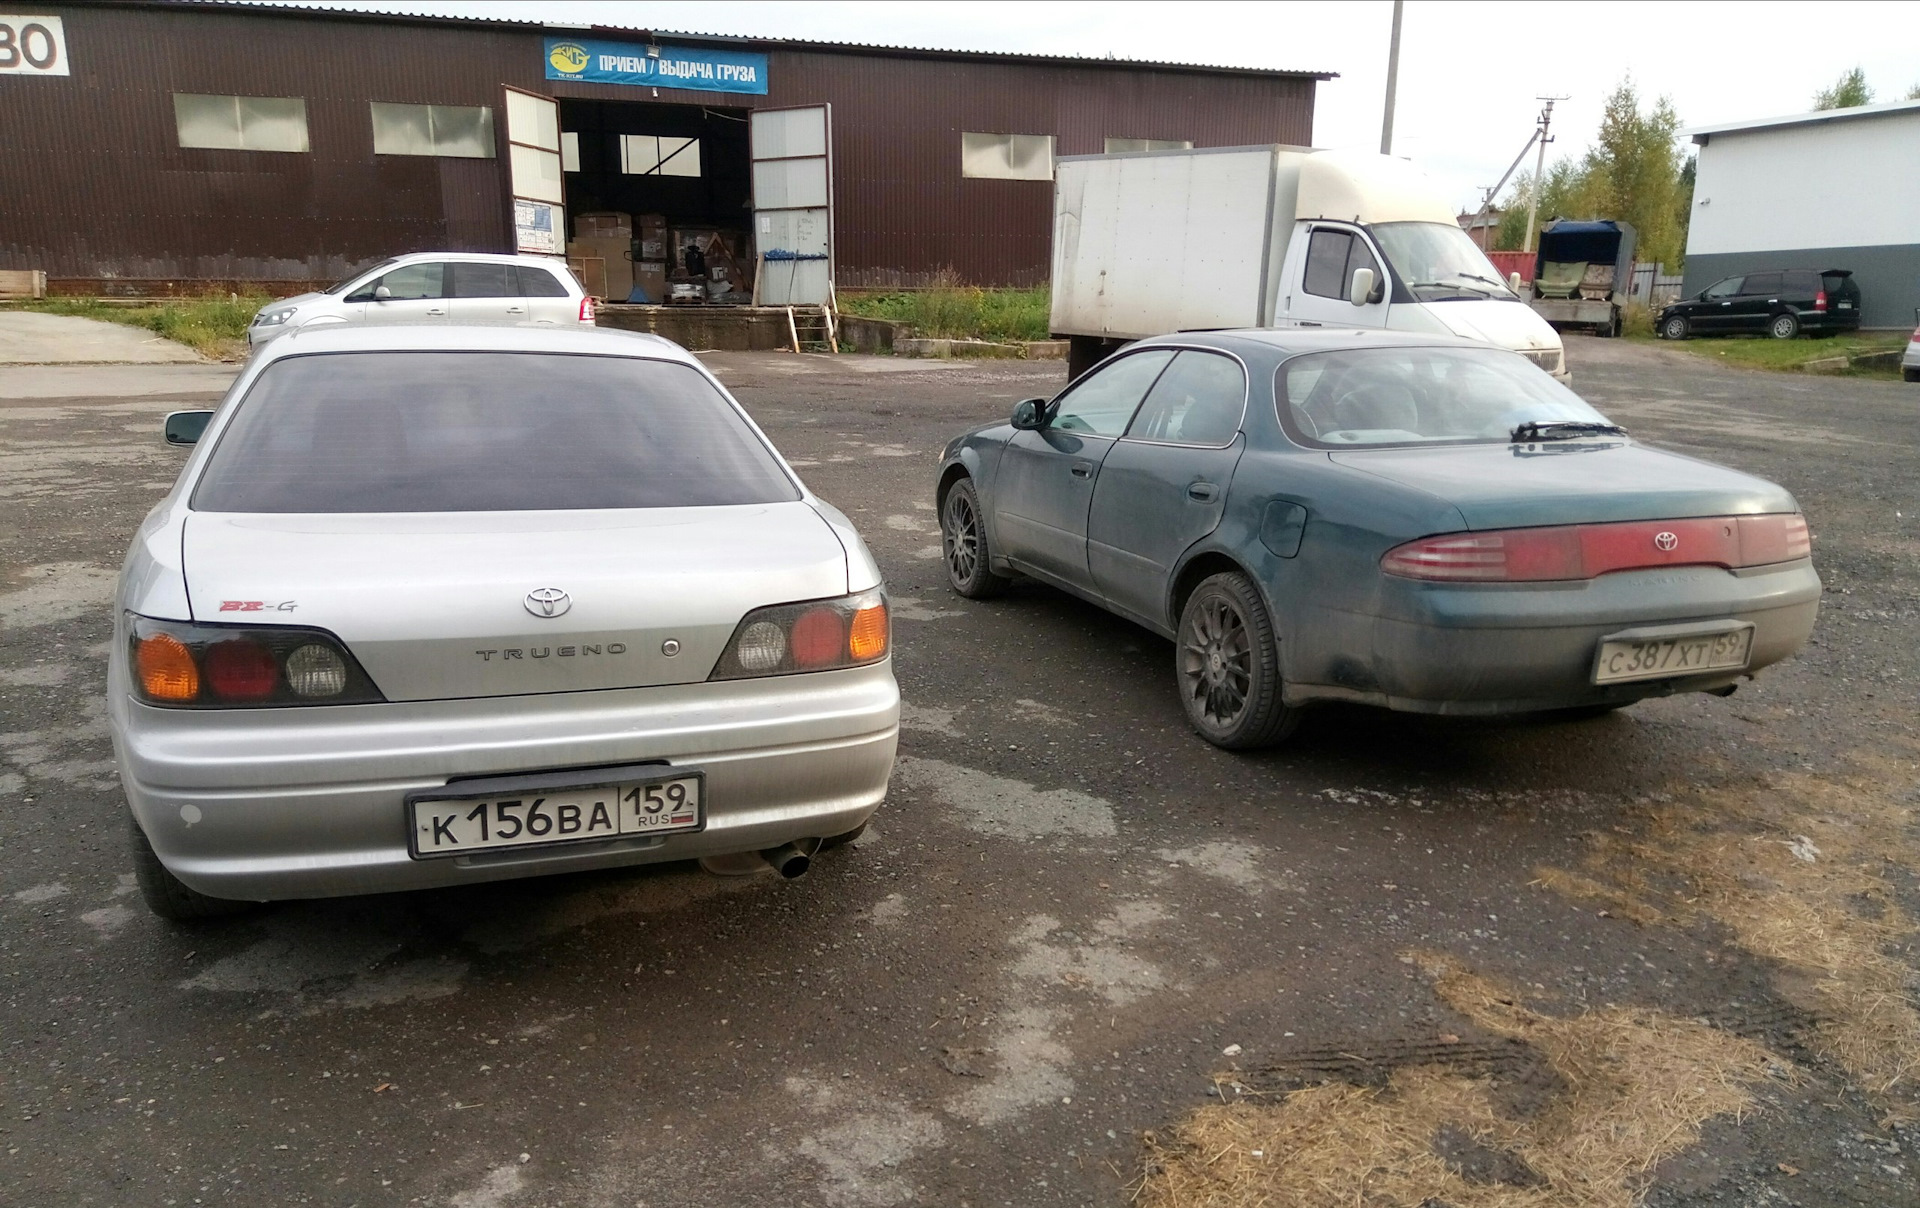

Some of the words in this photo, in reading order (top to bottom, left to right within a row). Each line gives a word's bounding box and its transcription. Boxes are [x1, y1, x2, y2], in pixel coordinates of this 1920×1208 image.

[599, 54, 647, 74] ПРИЕМ
[658, 58, 714, 80] ВЫДАЧА
[716, 63, 757, 83] ГРУЗА
[475, 642, 627, 662] TRUENO
[431, 798, 613, 846] К156ВА
[623, 783, 687, 816] 159
[638, 813, 670, 827] RUS
